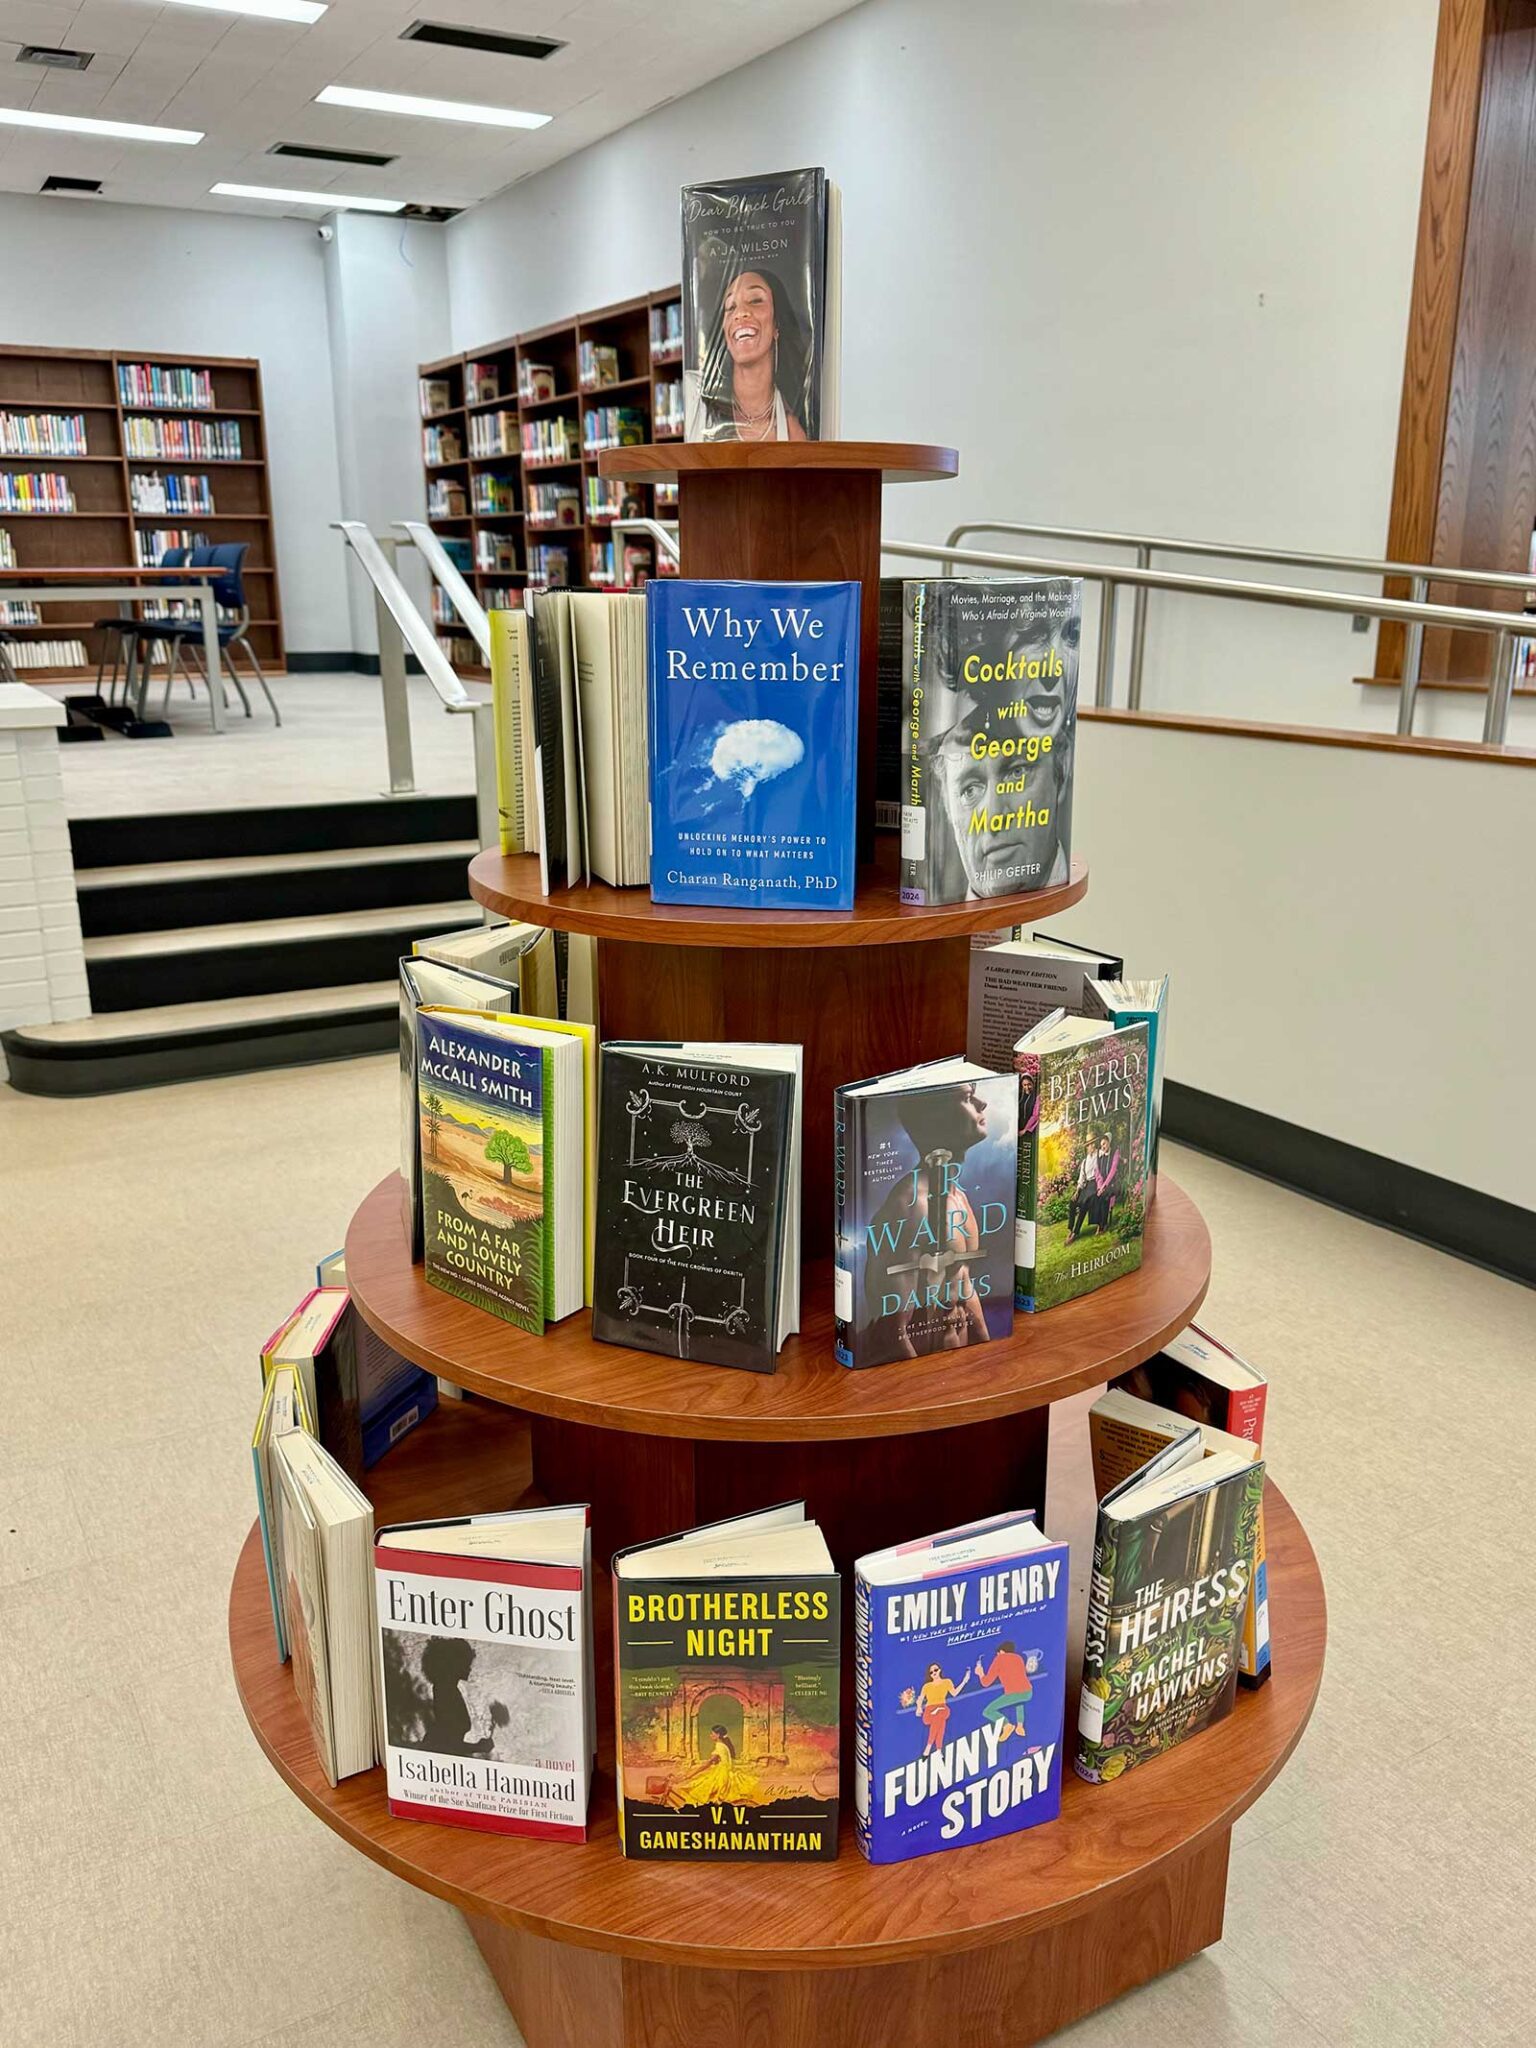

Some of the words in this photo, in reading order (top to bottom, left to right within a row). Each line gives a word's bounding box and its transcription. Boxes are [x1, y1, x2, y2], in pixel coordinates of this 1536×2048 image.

[688, 200, 724, 222] Dear
[772, 188, 814, 213] Girls
[710, 244, 736, 257] A'JA
[741, 238, 788, 253] WILSON
[950, 594, 980, 604] Movies,
[982, 594, 1018, 606] Marriage,
[1020, 592, 1034, 602] and
[1035, 592, 1046, 602] the
[1048, 591, 1072, 602] Making
[962, 610, 984, 621] Who's
[986, 610, 1008, 620] Afraid
[1010, 609, 1019, 619] of
[1020, 608, 1048, 620] Virginia
[682, 607, 762, 648] Why
[770, 608, 824, 639] We
[666, 650, 844, 682] Remember
[964, 650, 1062, 684] Cocktails
[910, 688, 924, 739] George
[997, 700, 1028, 720] with
[970, 732, 1052, 762] George
[911, 766, 922, 806] Marth
[996, 775, 1026, 794] and
[968, 800, 1050, 836] Martha
[678, 832, 727, 842] UNLOCKING
[731, 833, 776, 844] MEMORY'S
[780, 836, 811, 845] POWER
[816, 836, 826, 845] TO
[689, 847, 712, 856] HOLD
[716, 848, 727, 857] ON
[731, 848, 742, 858] TO
[746, 849, 769, 858] WHAT
[773, 850, 814, 860] MATTERS
[667, 870, 718, 885] Charan
[722, 872, 802, 890] Ranganath,
[805, 876, 838, 890] PhD
[974, 867, 1002, 882] PHILIP
[1006, 862, 1041, 878] GEFTER
[1011, 968, 1030, 976] PRINT
[1031, 971, 1058, 980] EDITION
[1012, 980, 1042, 989] WEATHER
[1043, 984, 1068, 992] FRIEND
[428, 1036, 522, 1079] ALEXANDER
[676, 1068, 750, 1087] MULFORD
[696, 1087, 722, 1095] MOUNTAIN
[1048, 1048, 1147, 1102] BEVERLY
[481, 1076, 532, 1108] SMITH
[1063, 1084, 1132, 1127] LEWIS
[1022, 1141, 1032, 1186] BEVERLY
[675, 1170, 704, 1190] THE
[622, 1180, 756, 1225] EVERGREEN
[438, 1210, 477, 1240] FROM
[480, 1229, 492, 1245] A
[495, 1234, 522, 1259] FAR
[652, 1218, 715, 1255] HEIR
[864, 1202, 1008, 1256] WARD
[437, 1229, 468, 1250] AND
[472, 1242, 522, 1277] LOVELY
[628, 1252, 644, 1260] BOOK
[690, 1264, 714, 1272] CROWNS
[1053, 1271, 1069, 1284] The
[1070, 1242, 1130, 1280] HEIRLOOM
[446, 1250, 514, 1291] COUNTRY
[432, 1262, 440, 1270] THE
[476, 1282, 498, 1296] DETECTIVE
[498, 1292, 515, 1306] AGENCY
[515, 1300, 530, 1313] NOVEL
[881, 1274, 992, 1317] DARIUS
[1093, 1544, 1104, 1570] THE
[628, 1591, 829, 1623] BROTHERLESS
[887, 1582, 968, 1636] EMILY
[980, 1560, 1060, 1616] HENRY
[1118, 1559, 1248, 1655] HEIRESS
[1134, 1578, 1165, 1609] THE
[386, 1578, 474, 1630] Enter
[484, 1591, 576, 1642] Ghost
[948, 1623, 968, 1632] TIMES
[970, 1613, 1013, 1628] BESTSELLING
[1015, 1607, 1037, 1617] AUTHOR
[1085, 1572, 1111, 1668] HEIRESS
[686, 1628, 774, 1657] NIGHT
[948, 1632, 975, 1645] HAPPY
[977, 1626, 1001, 1638] PLACE
[1129, 1636, 1208, 1698] RACHEL
[1135, 1652, 1228, 1721] HAWKINS
[398, 1754, 476, 1790] Isabella
[486, 1767, 576, 1802] Hammad
[535, 1758, 541, 1768] a
[546, 1759, 576, 1772] novel
[884, 1716, 1005, 1818] FUNNY
[404, 1789, 428, 1802] Winner
[430, 1794, 438, 1803] of
[438, 1794, 449, 1804] the
[451, 1798, 464, 1807] Sue
[466, 1800, 497, 1812] Kaufman
[498, 1804, 516, 1814] Prize
[518, 1806, 529, 1816] for
[531, 1807, 548, 1818] First
[550, 1810, 574, 1822] Fiction
[476, 1794, 496, 1802] THE
[500, 1797, 548, 1808] PARISIAN
[940, 1742, 1056, 1840] STORY
[710, 1806, 727, 1825] V.
[734, 1806, 750, 1825] V.
[908, 1819, 930, 1834] NOVEL
[639, 1831, 822, 1850] GANESHANANTHAN
